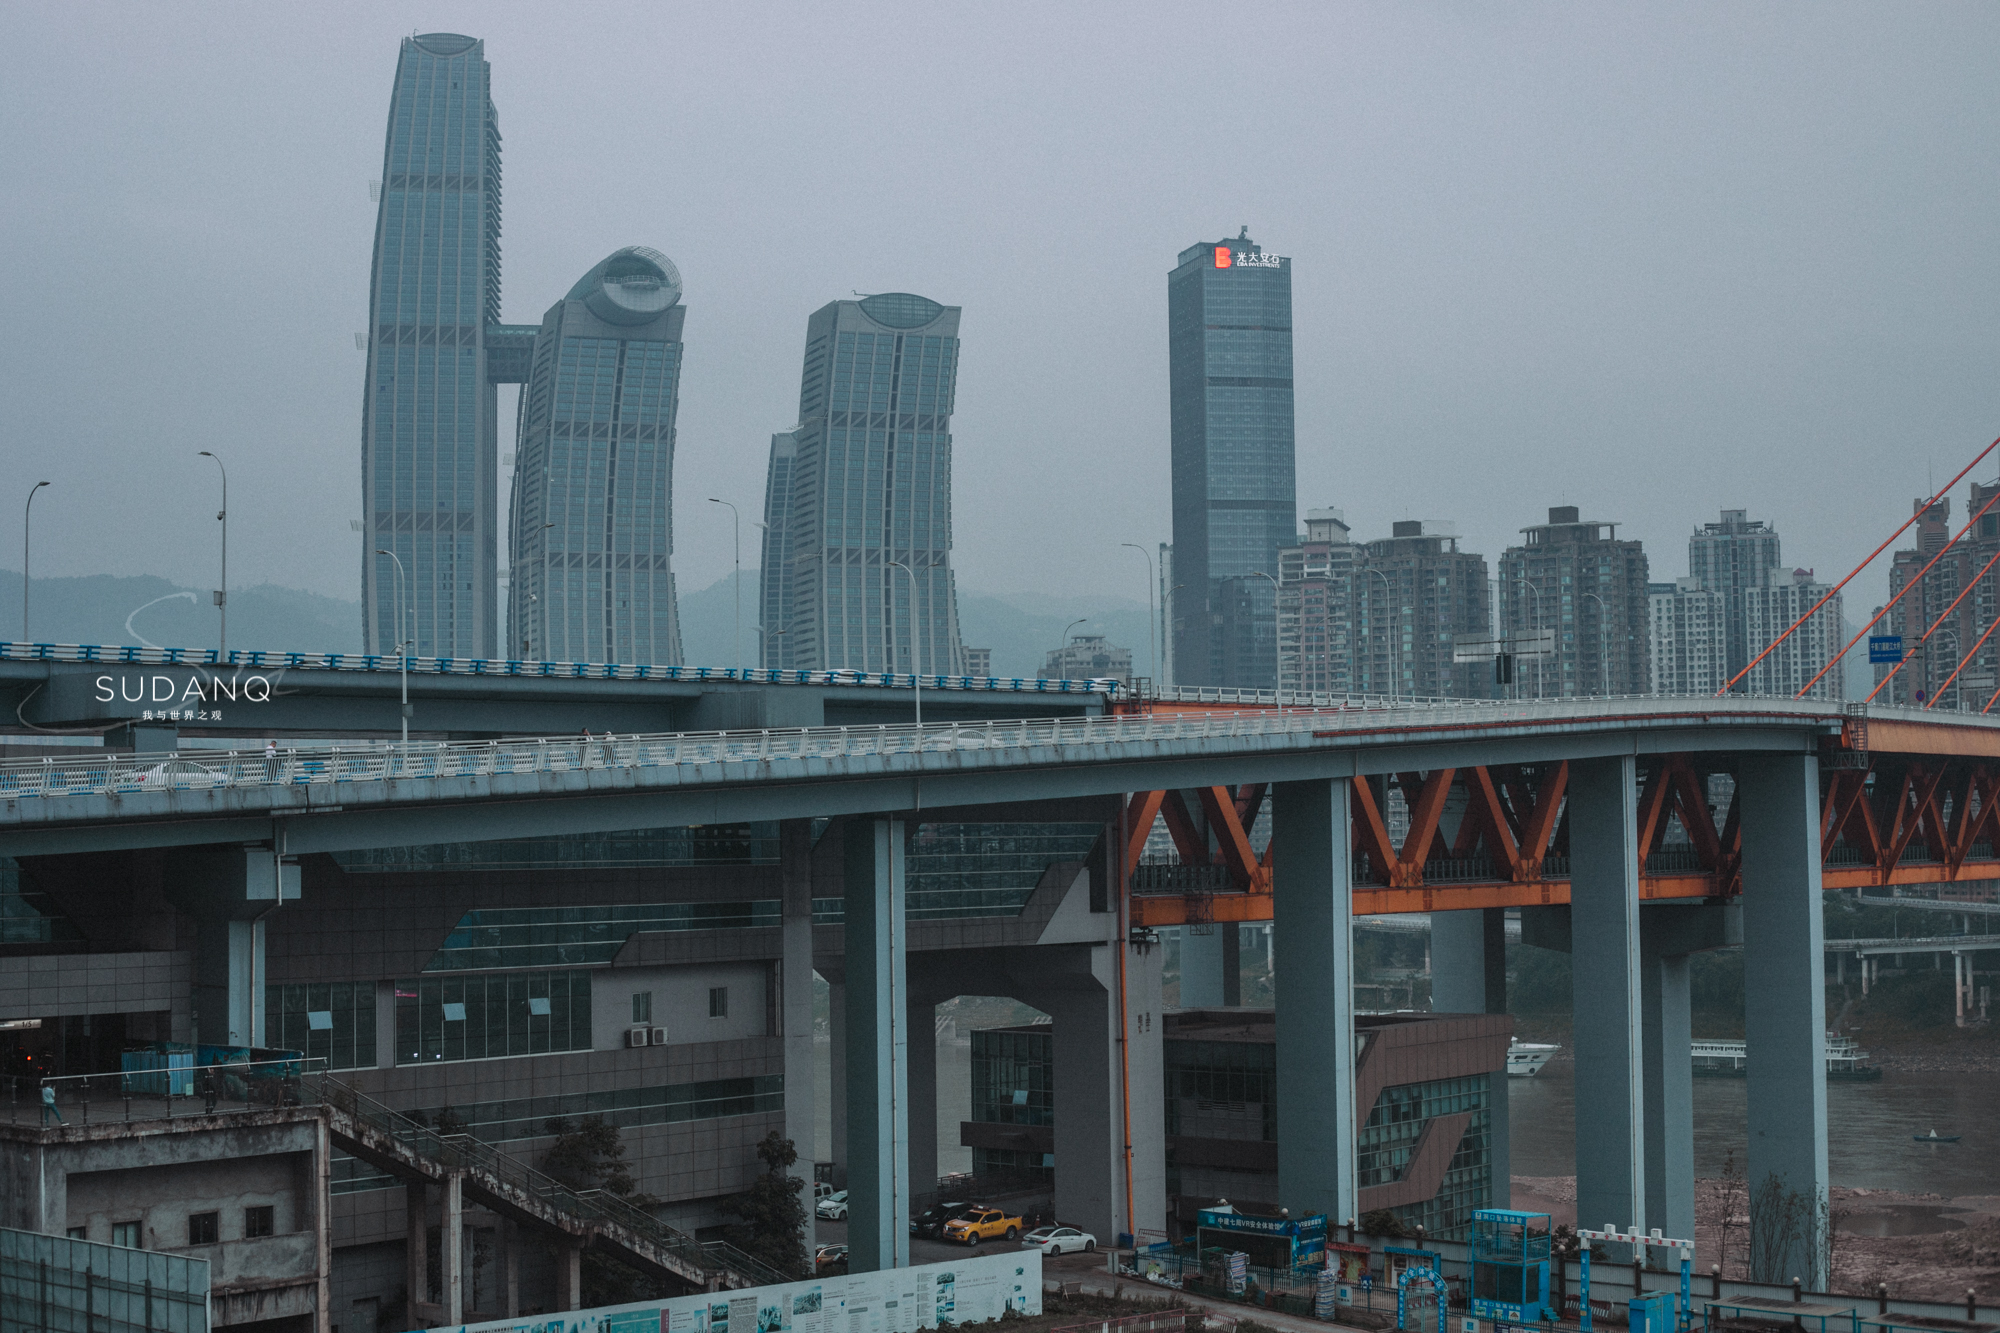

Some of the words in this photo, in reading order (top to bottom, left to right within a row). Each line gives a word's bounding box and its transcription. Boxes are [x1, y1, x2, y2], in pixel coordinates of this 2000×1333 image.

[1237, 252, 1280, 264] 光大安石
[1218, 1217, 1281, 1231] 中建七局VR安全体验馆
[1400, 1267, 1444, 1290] 安全体验区
